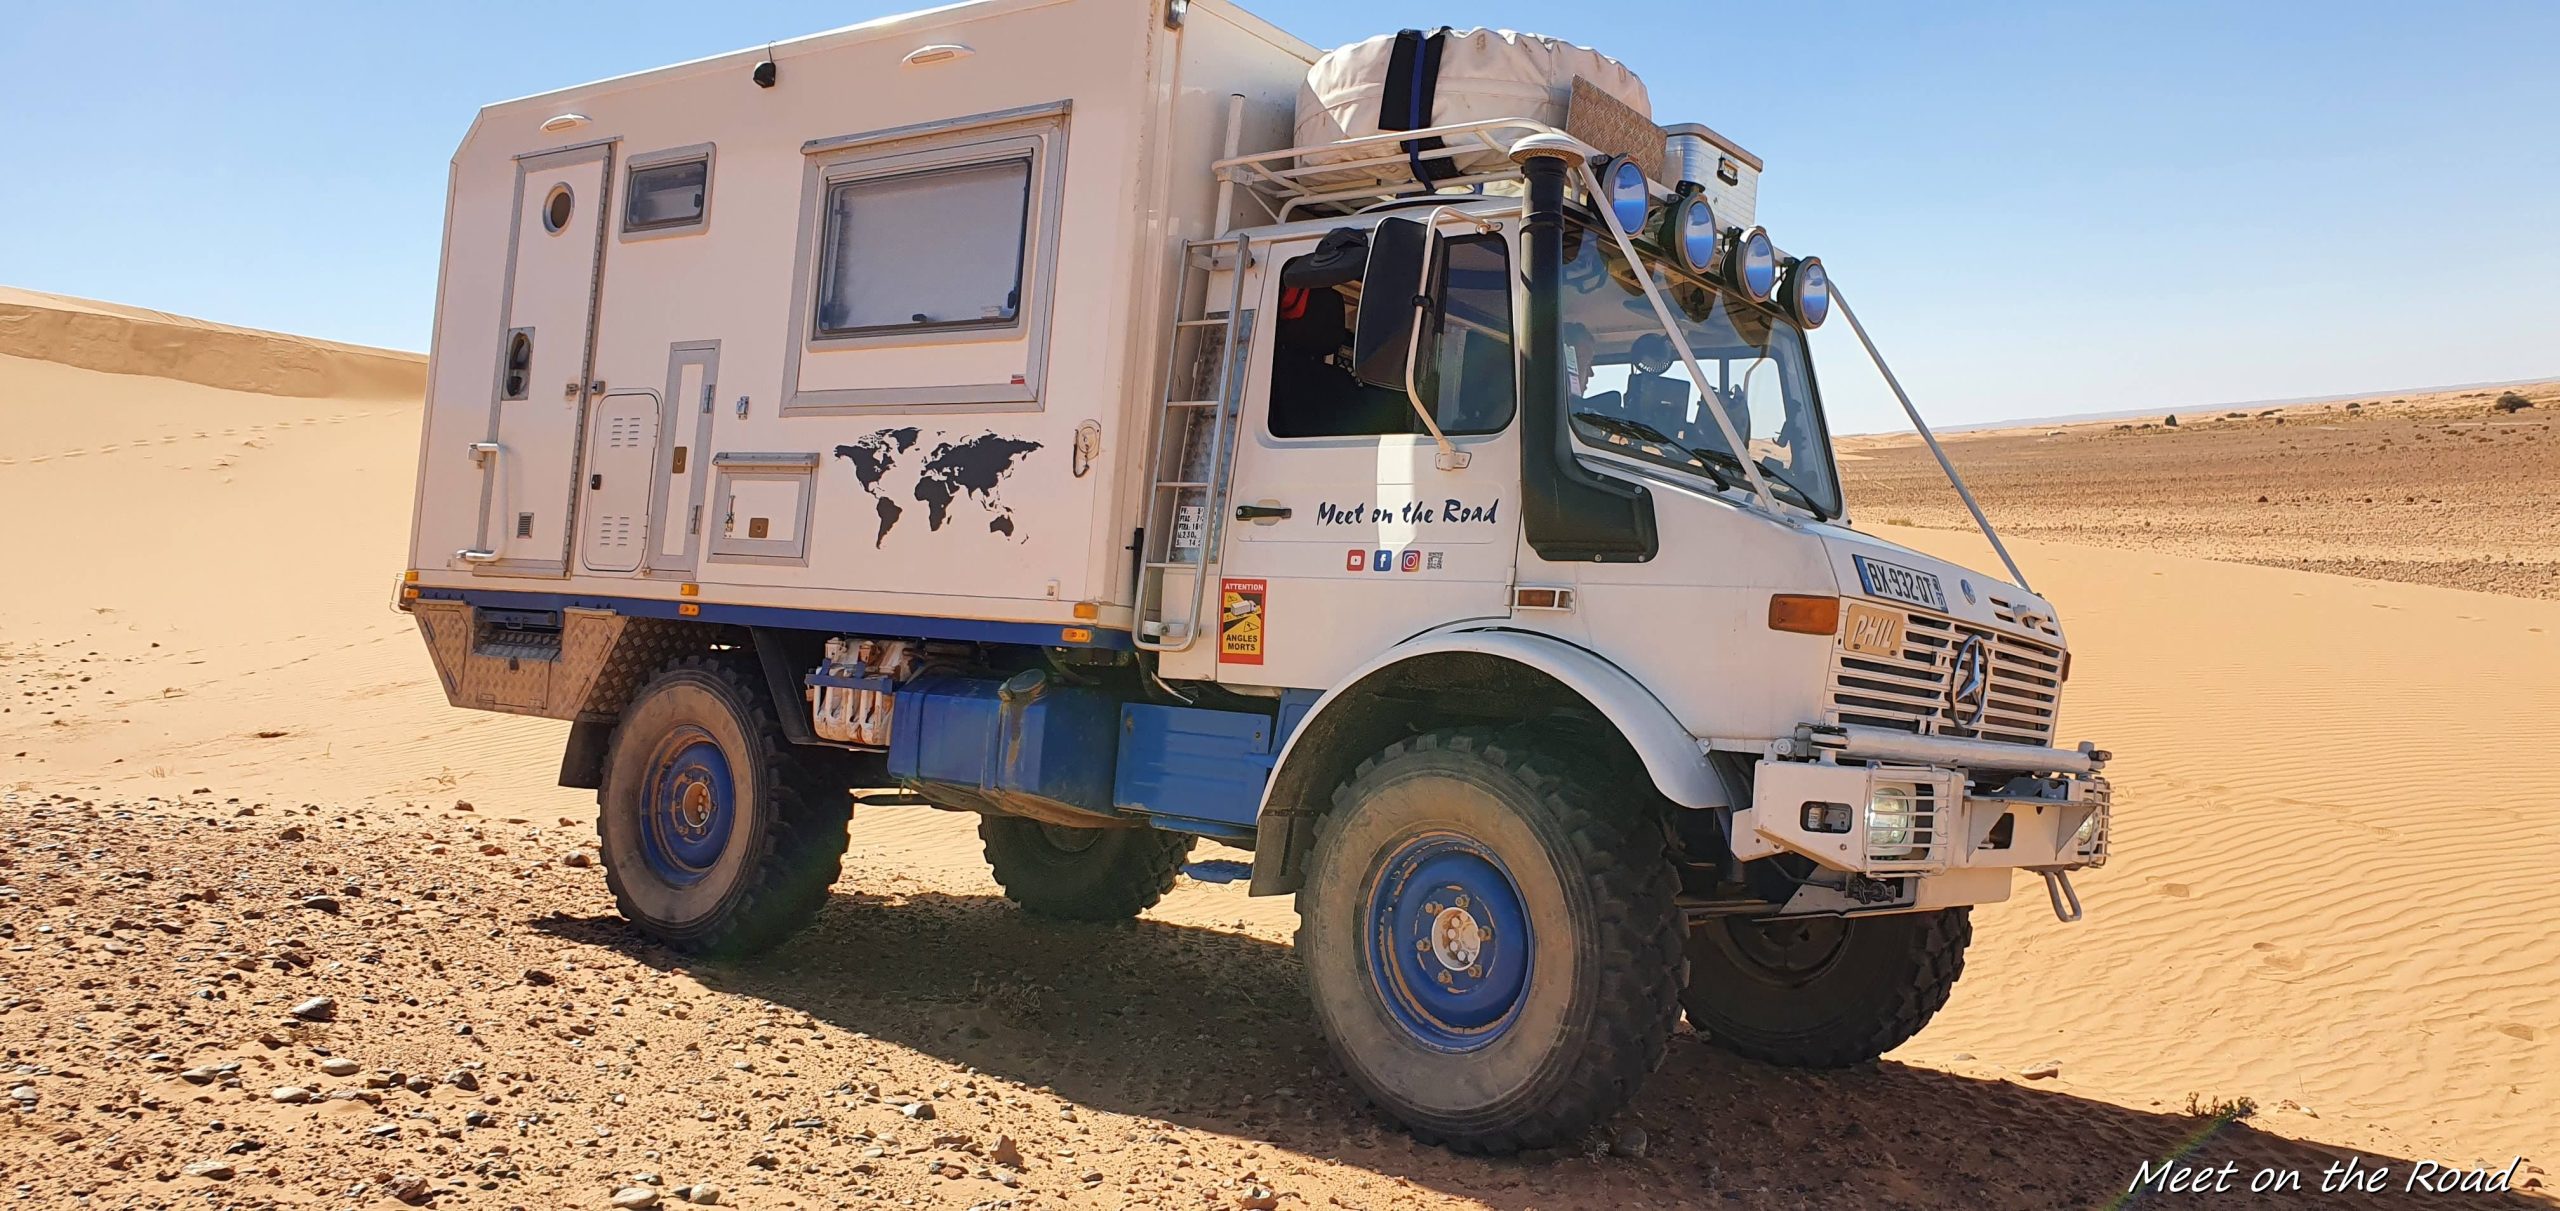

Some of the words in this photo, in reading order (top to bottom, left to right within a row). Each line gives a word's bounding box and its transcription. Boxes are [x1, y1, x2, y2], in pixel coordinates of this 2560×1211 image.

[1316, 501, 1365, 527] Meet
[1371, 507, 1394, 525] on
[1402, 499, 1434, 525] the
[1442, 497, 1501, 525] Road
[1224, 583, 1264, 591] ATTENTION
[1853, 614, 1896, 649] PHIL
[1226, 633, 1258, 643] ANGLES
[1227, 642, 1256, 651] MORTS
